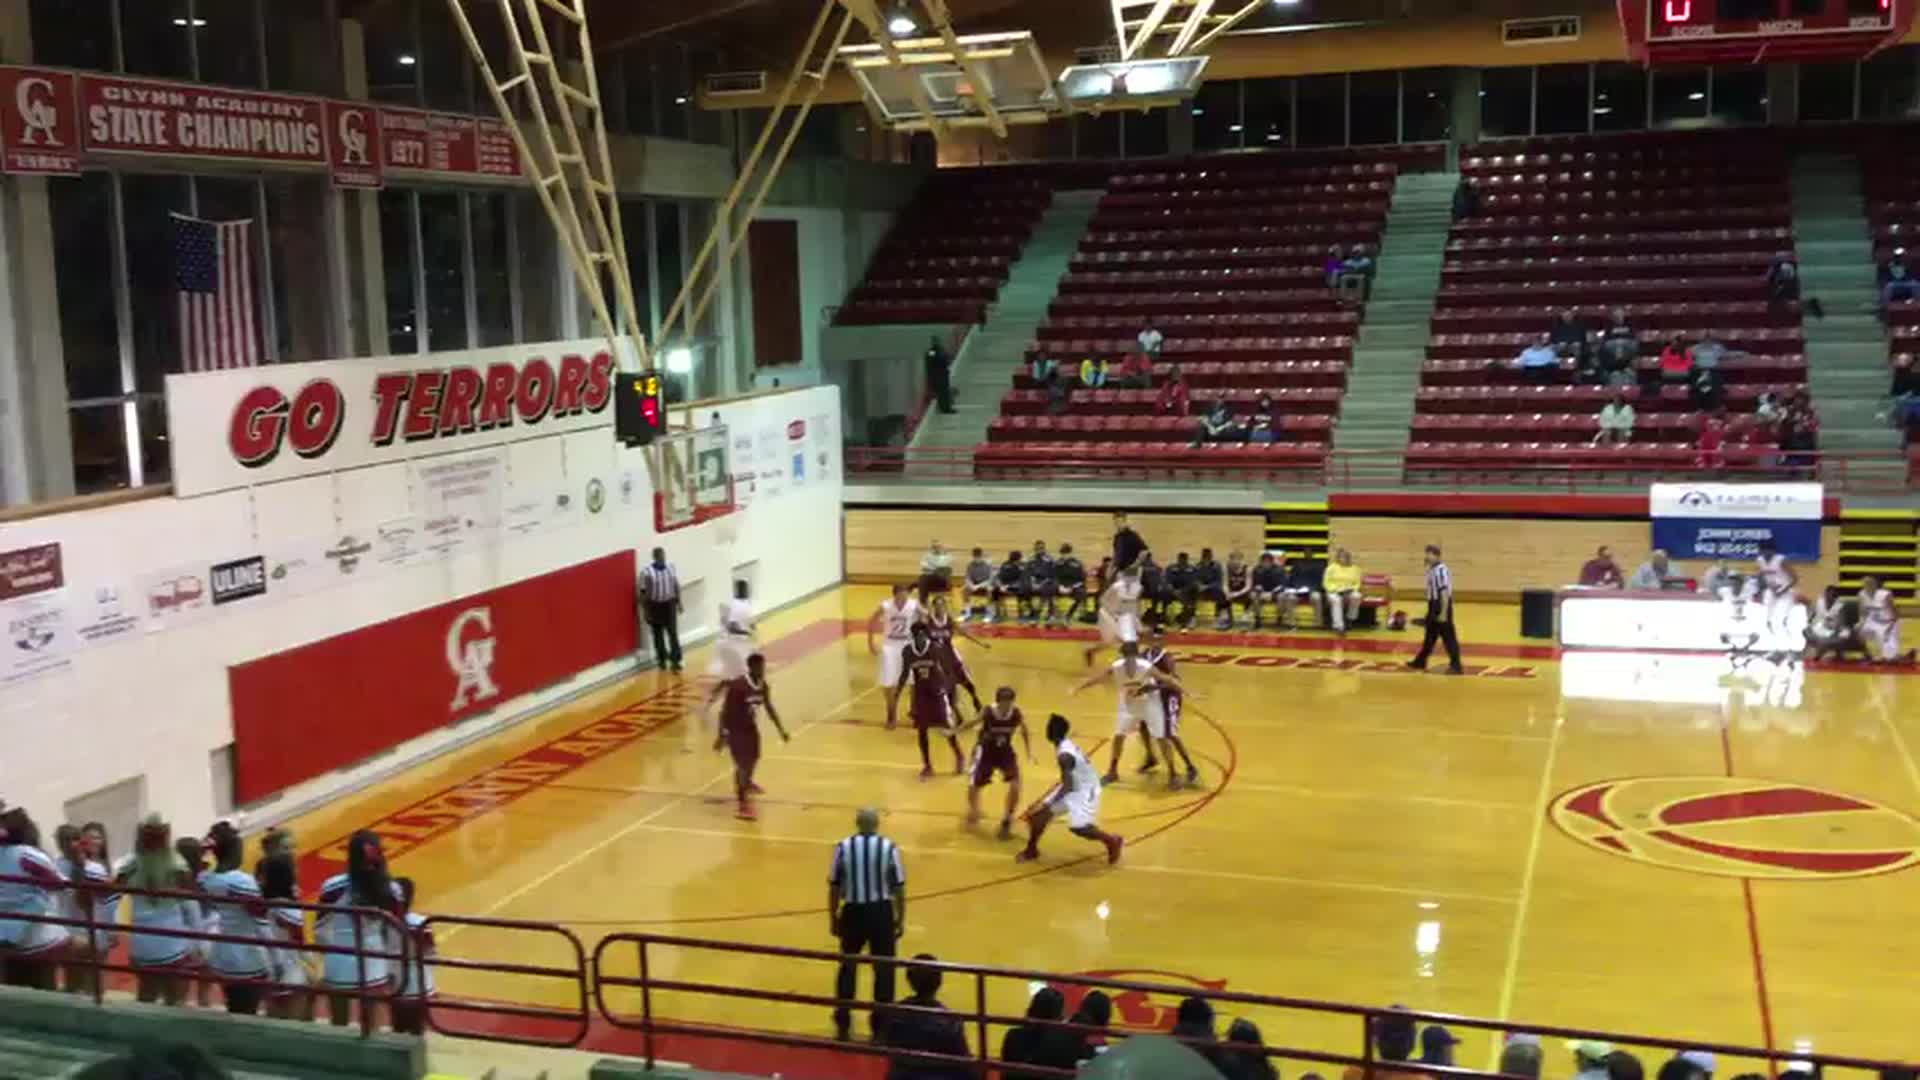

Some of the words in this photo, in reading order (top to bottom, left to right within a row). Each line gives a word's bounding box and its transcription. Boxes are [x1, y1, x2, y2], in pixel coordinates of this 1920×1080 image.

[102, 86, 185, 107] GLYNN
[196, 95, 304, 119] ACADEMY
[90, 104, 169, 145] STATE
[177, 111, 321, 155] CHAMPIONS
[228, 385, 345, 468] GO
[370, 351, 617, 447] TERRORS
[213, 559, 264, 594] ULINE
